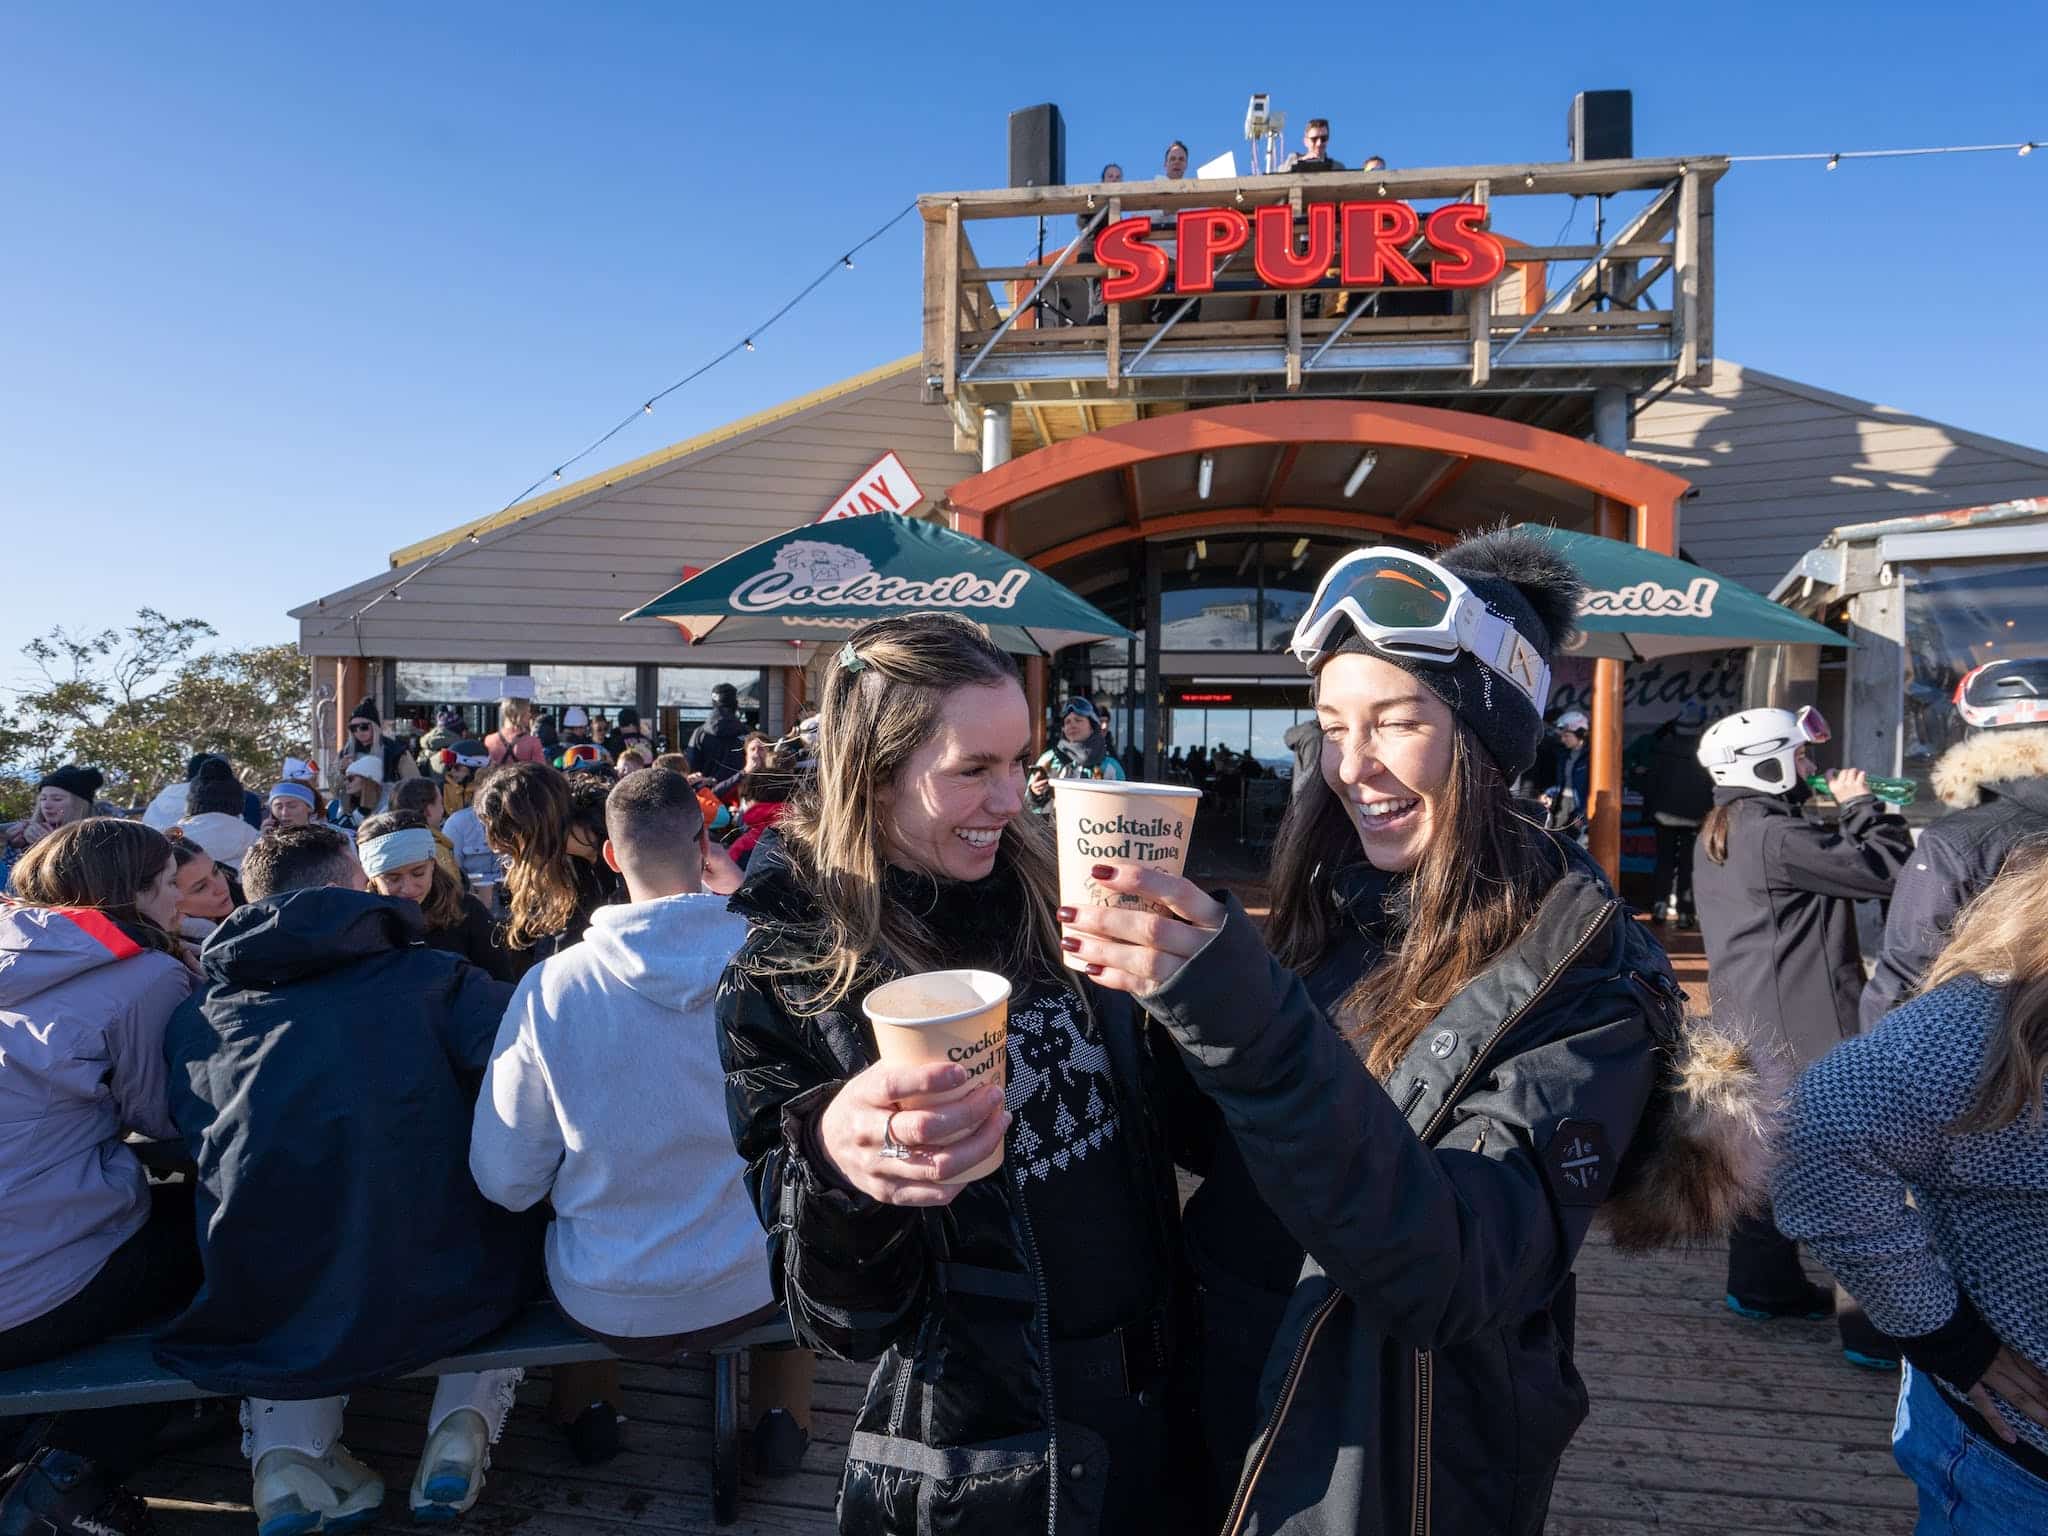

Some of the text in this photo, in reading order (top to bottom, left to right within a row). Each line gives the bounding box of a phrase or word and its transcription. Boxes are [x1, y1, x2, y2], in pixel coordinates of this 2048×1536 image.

[1094, 201, 1505, 303] SPURS
[730, 569, 1030, 611] Cocktails!
[1578, 578, 1718, 617] ails!
[1079, 815, 1184, 840] Cocktails &
[1077, 838, 1130, 858] Good
[966, 1051, 994, 1080] ood
